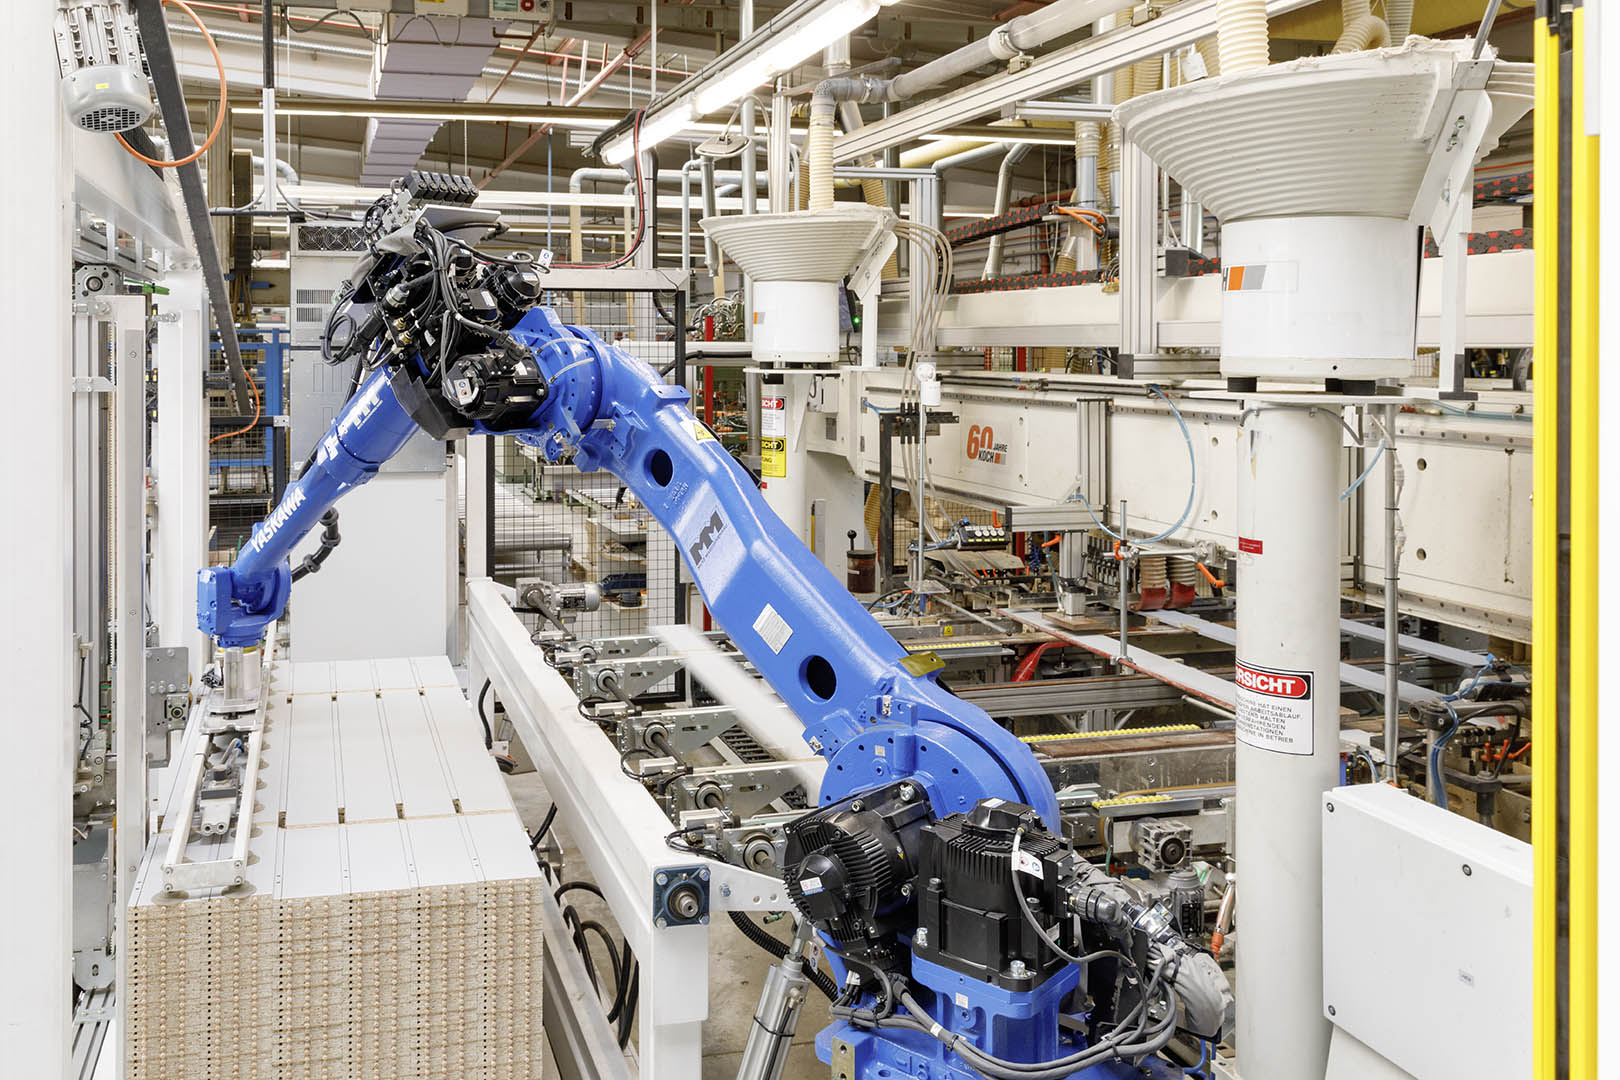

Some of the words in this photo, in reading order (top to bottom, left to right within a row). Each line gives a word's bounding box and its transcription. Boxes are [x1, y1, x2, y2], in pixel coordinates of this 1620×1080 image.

[967, 424, 993, 459] 60
[978, 450, 994, 463] KOCH
[251, 486, 306, 552] YASKAWA
[690, 510, 724, 566] MM
[1271, 704, 1292, 713] EINEN
[1260, 715, 1286, 724] HALTEN
[1265, 734, 1294, 743] BETRIEB
